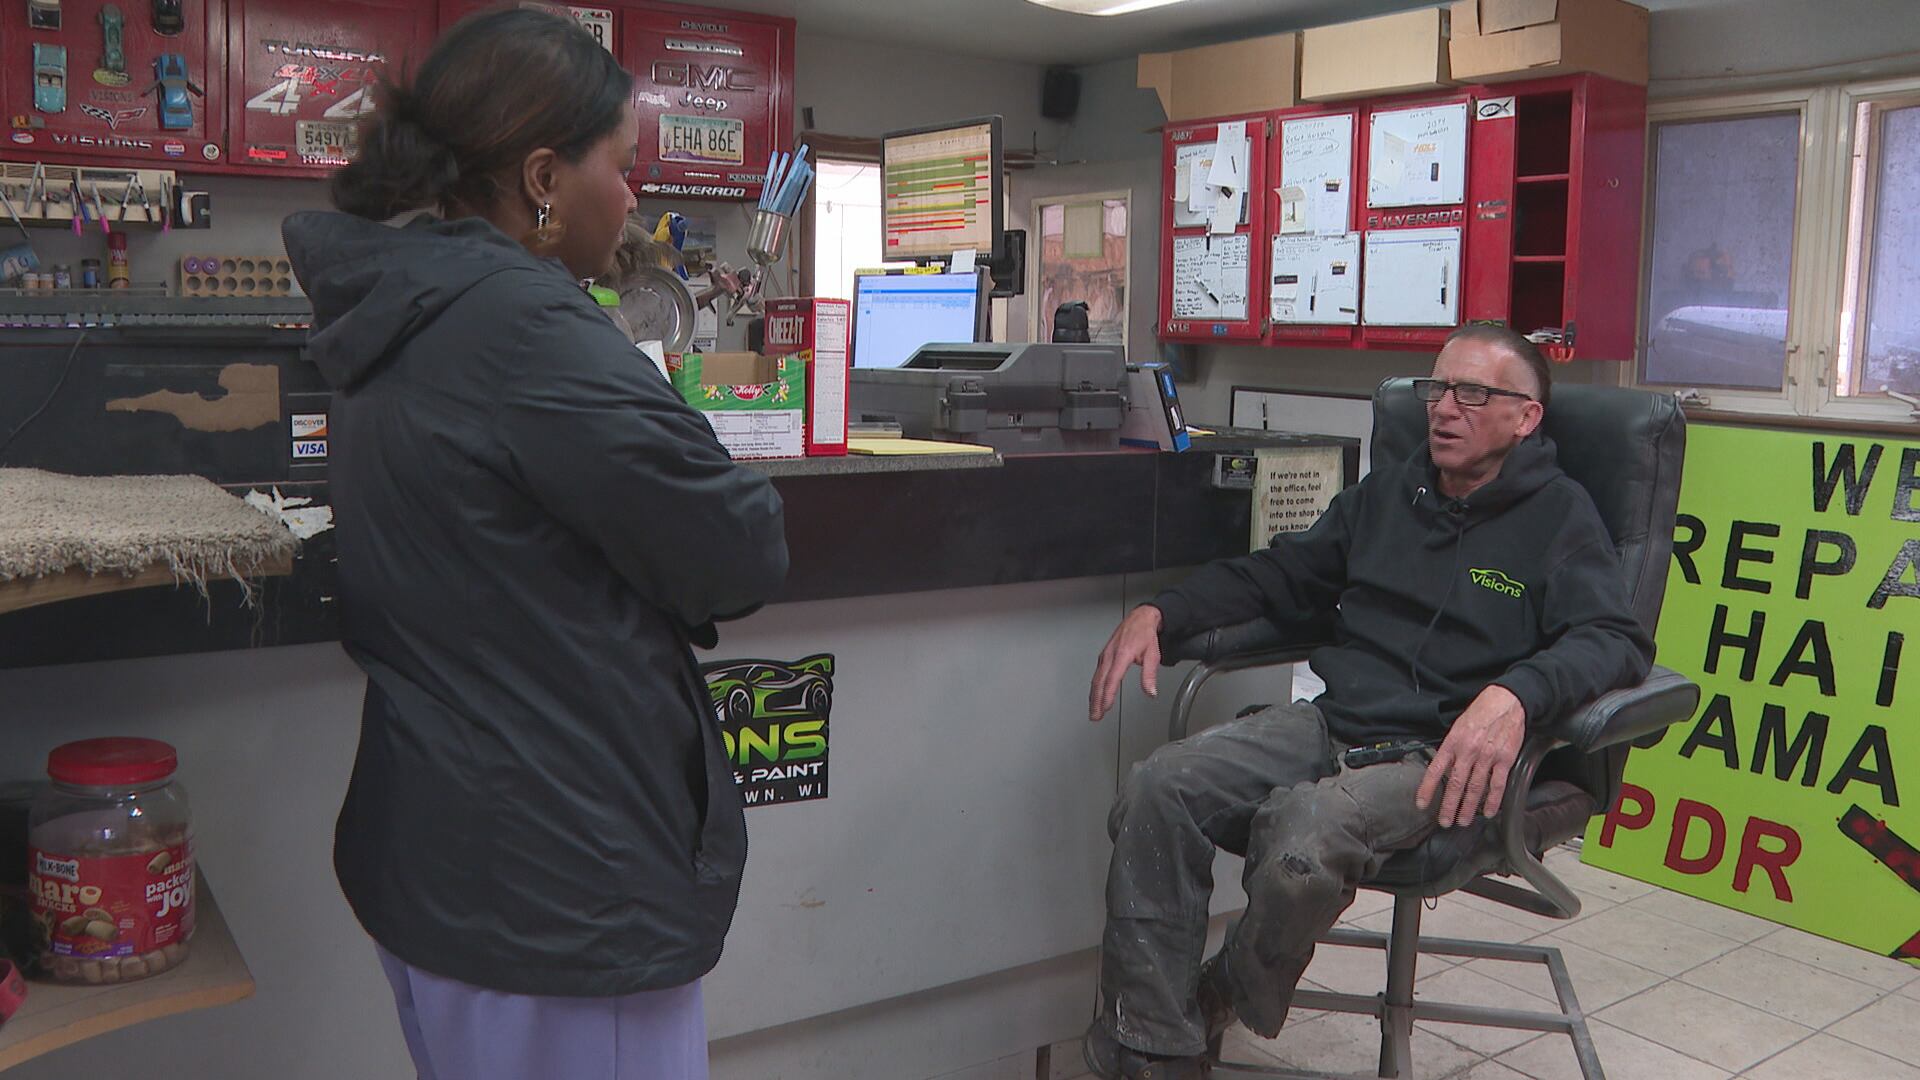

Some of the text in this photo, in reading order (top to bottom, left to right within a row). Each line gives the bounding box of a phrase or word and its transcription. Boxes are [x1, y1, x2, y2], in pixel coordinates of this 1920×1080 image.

[651, 60, 755, 91] GMC
[678, 91, 727, 111] Jeep
[52, 134, 152, 149] VISIONS
[673, 126, 736, 153] EHA 86E
[660, 184, 746, 197] SILVERADO
[1368, 210, 1463, 227] SILVERADO
[769, 315, 804, 344] CHEEZ-IT
[735, 384, 762, 397] Kelly
[297, 443, 325, 454] VISA
[1270, 470, 1320, 480] If we're not in
[1812, 441, 1920, 522] WE
[1270, 483, 1321, 494] the office, feel
[1270, 497, 1314, 506] free to come
[1269, 509, 1324, 520] into the shop to
[1269, 524, 1278, 532] let
[1290, 522, 1310, 531] know
[1471, 572, 1522, 598] Visions
[1703, 604, 1904, 707] HAI
[1630, 693, 1900, 807] AMA
[752, 761, 824, 783] PAINT
[798, 782, 822, 798] WI
[1600, 782, 1802, 903] PDR
[146, 870, 191, 898] packed
